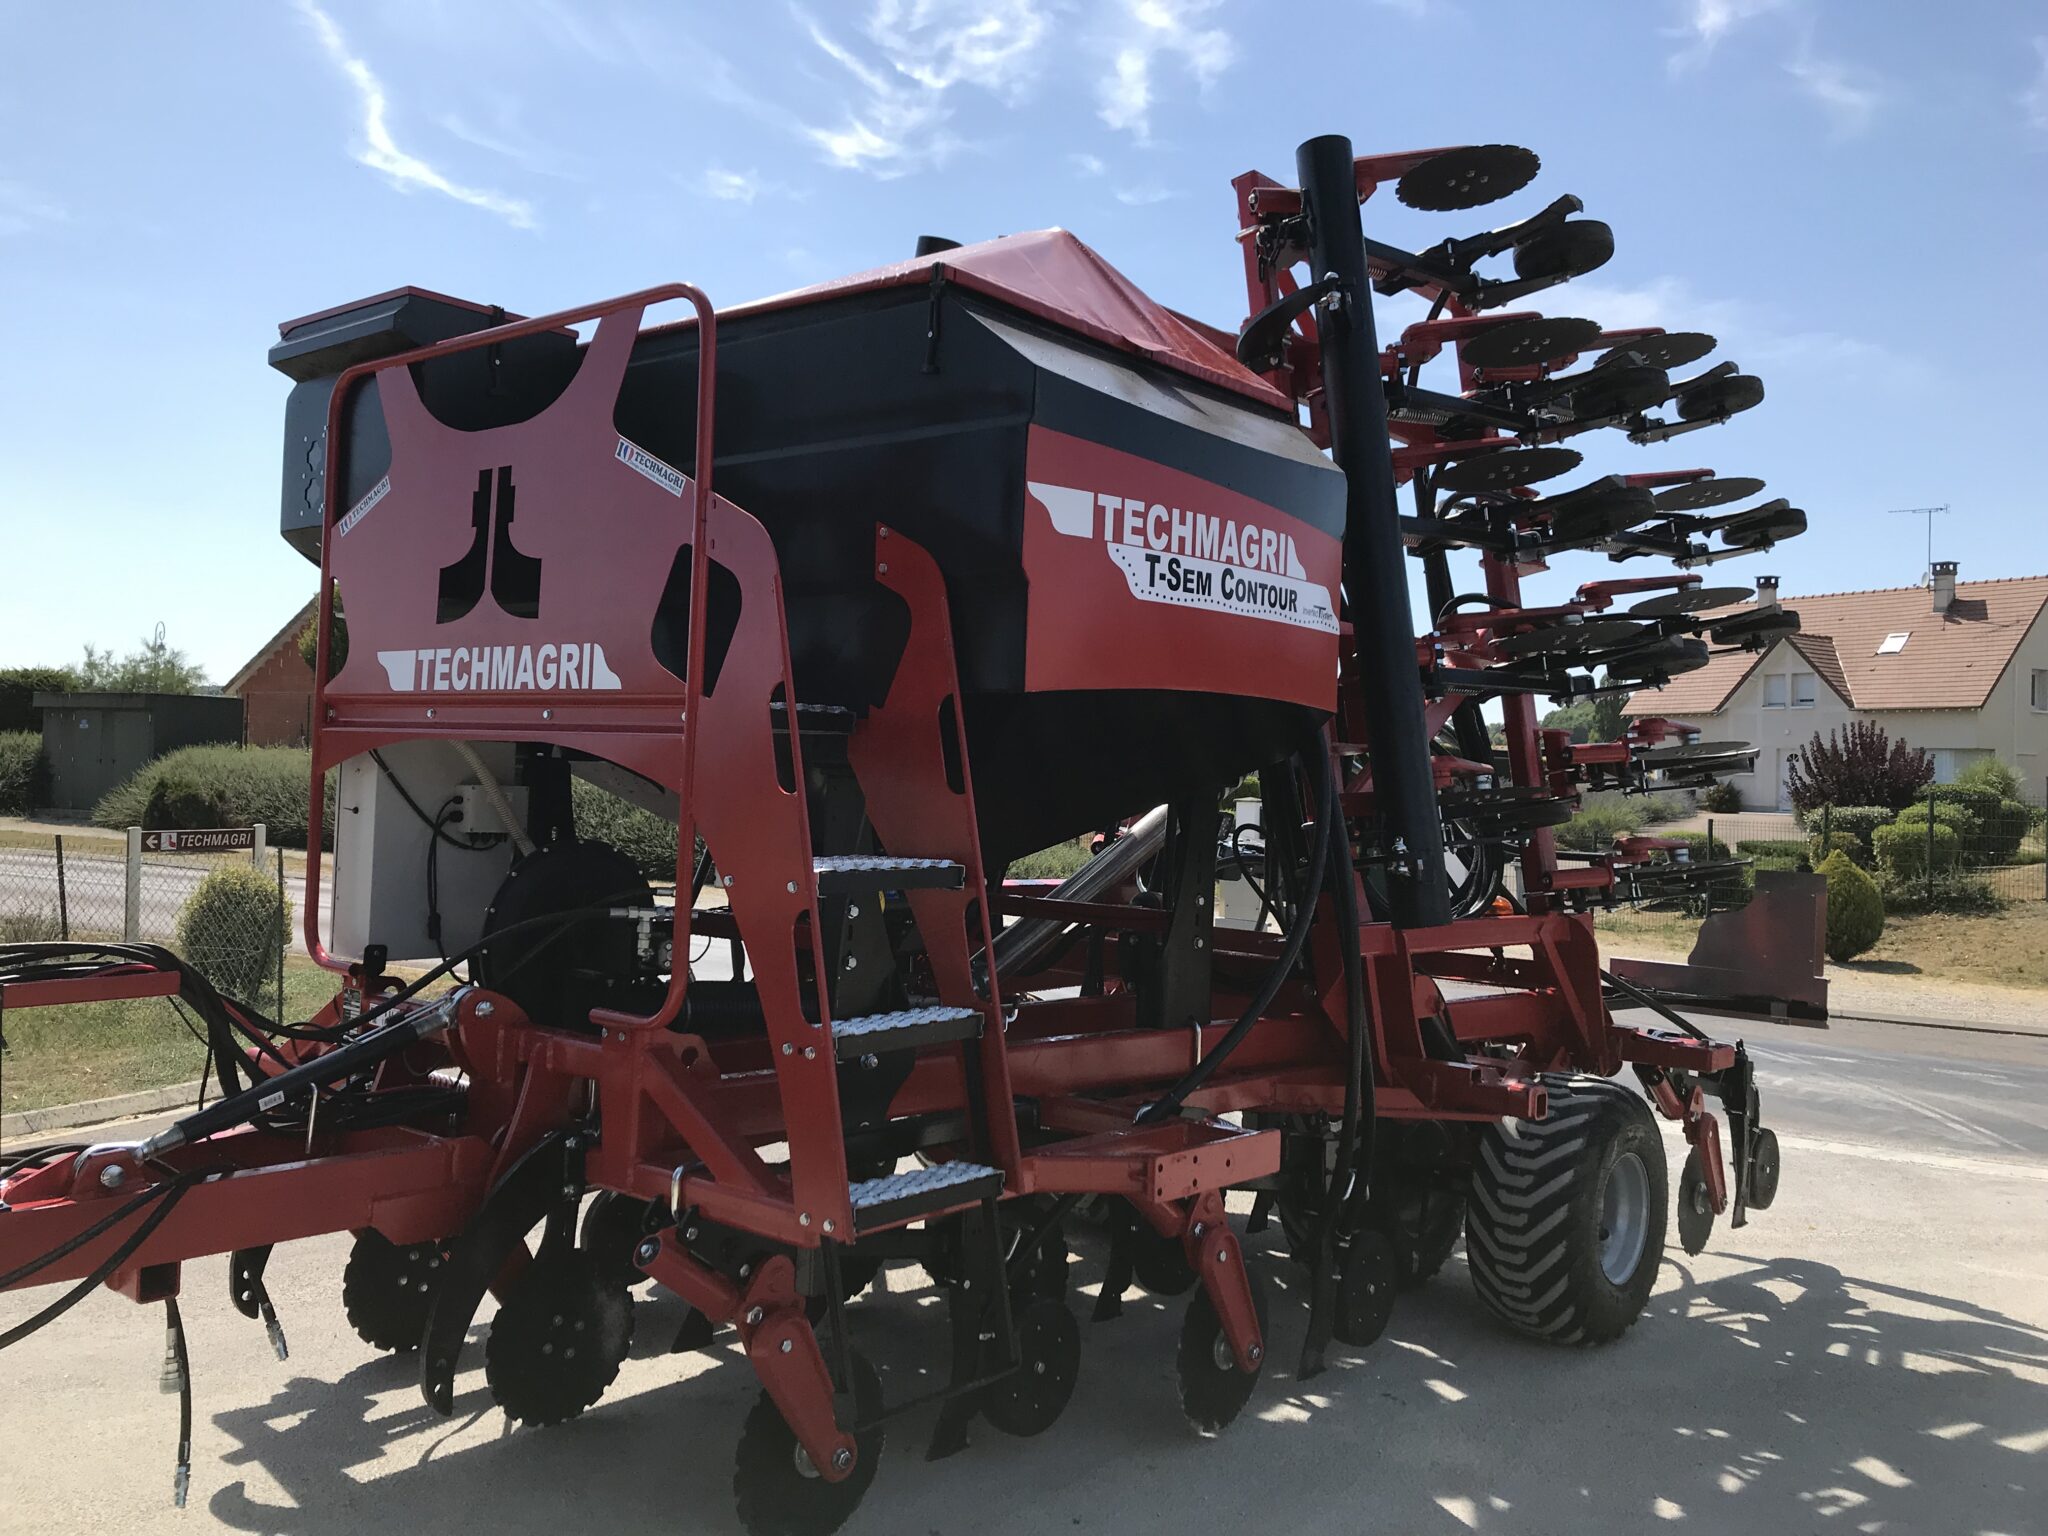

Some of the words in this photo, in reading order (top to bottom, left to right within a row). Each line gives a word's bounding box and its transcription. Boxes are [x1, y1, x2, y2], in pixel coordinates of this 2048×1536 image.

[635, 452, 684, 489] TECHMAGRI
[352, 478, 388, 518] TECHMAGRI
[1098, 494, 1286, 574] TECHMAGRI
[418, 643, 591, 690] TECHMAGRI
[180, 833, 250, 846] TECHMAGRI
